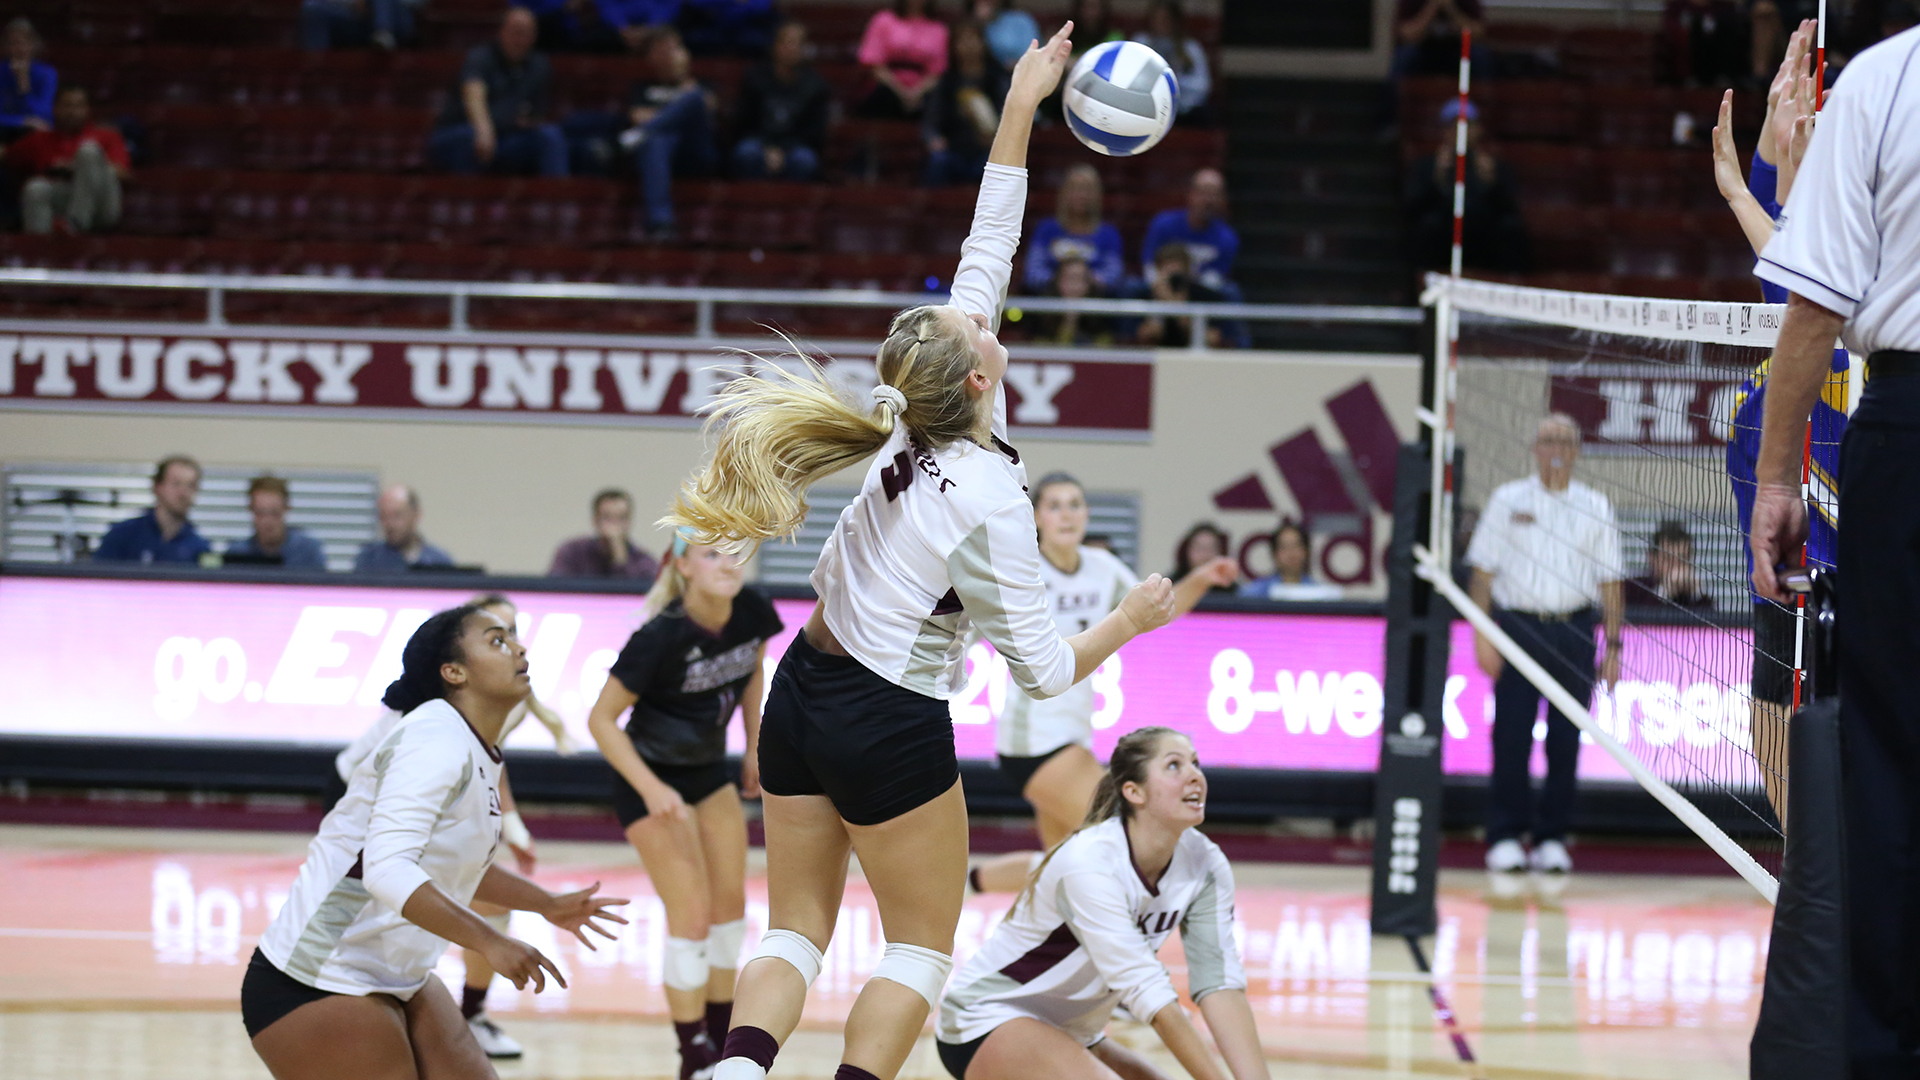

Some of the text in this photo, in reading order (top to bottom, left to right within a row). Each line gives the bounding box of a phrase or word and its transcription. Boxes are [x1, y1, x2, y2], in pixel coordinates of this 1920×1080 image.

[0, 336, 1076, 426] TUCKY UNIVESY
[1206, 647, 1470, 740] 8-wek
[1136, 909, 1181, 936] KU
